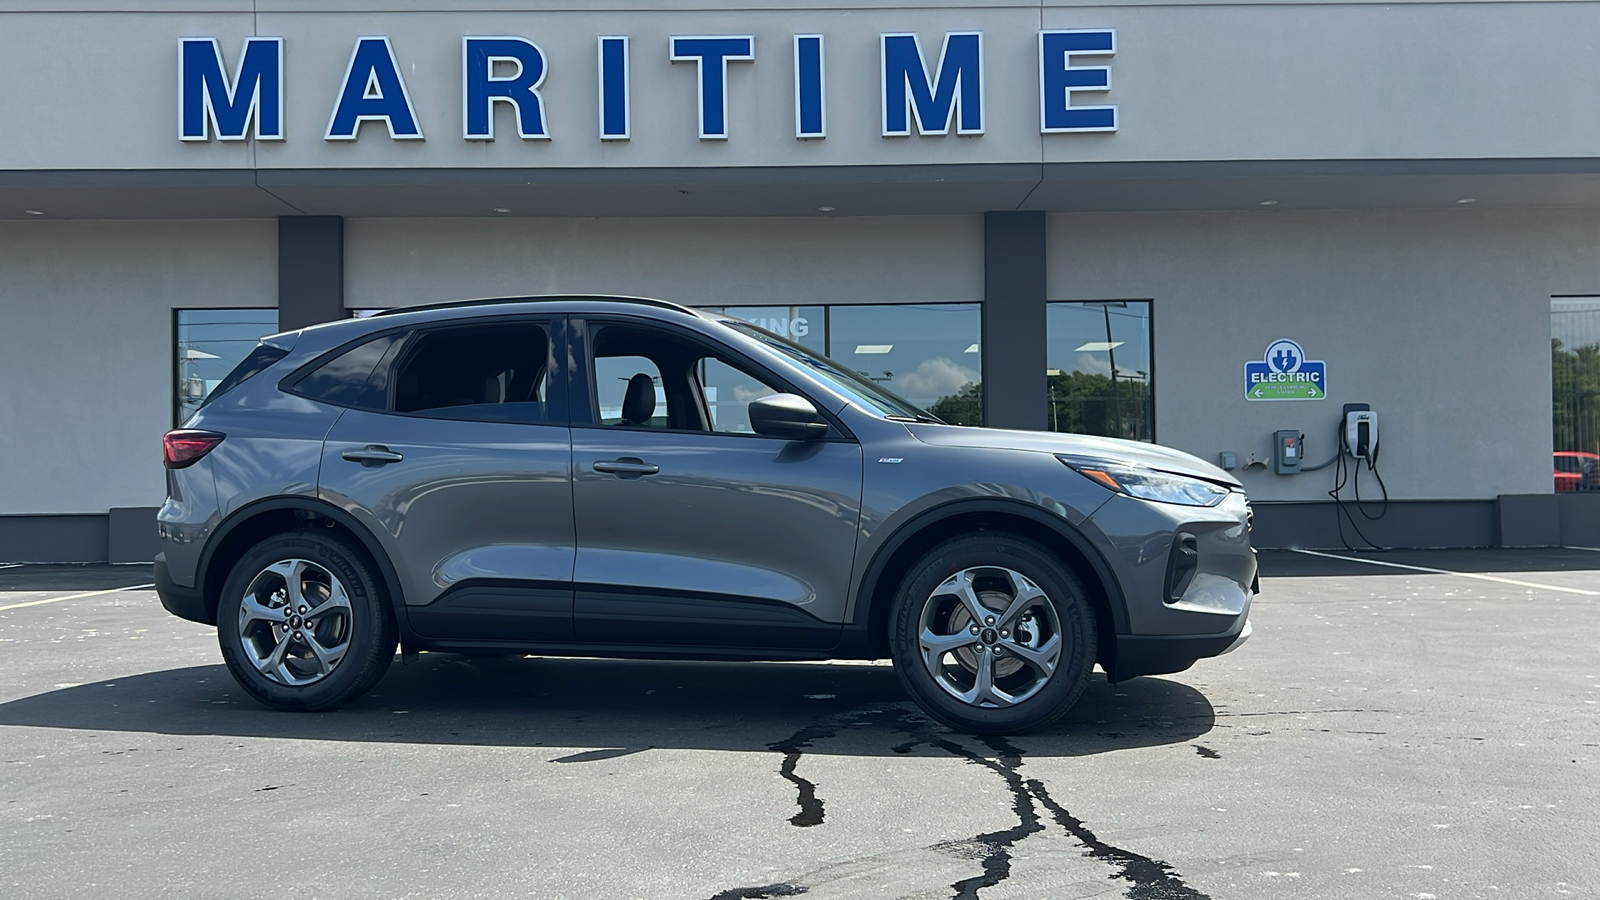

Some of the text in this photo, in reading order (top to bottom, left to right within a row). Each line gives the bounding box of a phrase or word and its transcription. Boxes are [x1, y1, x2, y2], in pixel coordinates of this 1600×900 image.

[178, 27, 1119, 141] MARITIME
[1251, 371, 1320, 383] ELECTRIC
[331, 555, 362, 595] MICHELIN
